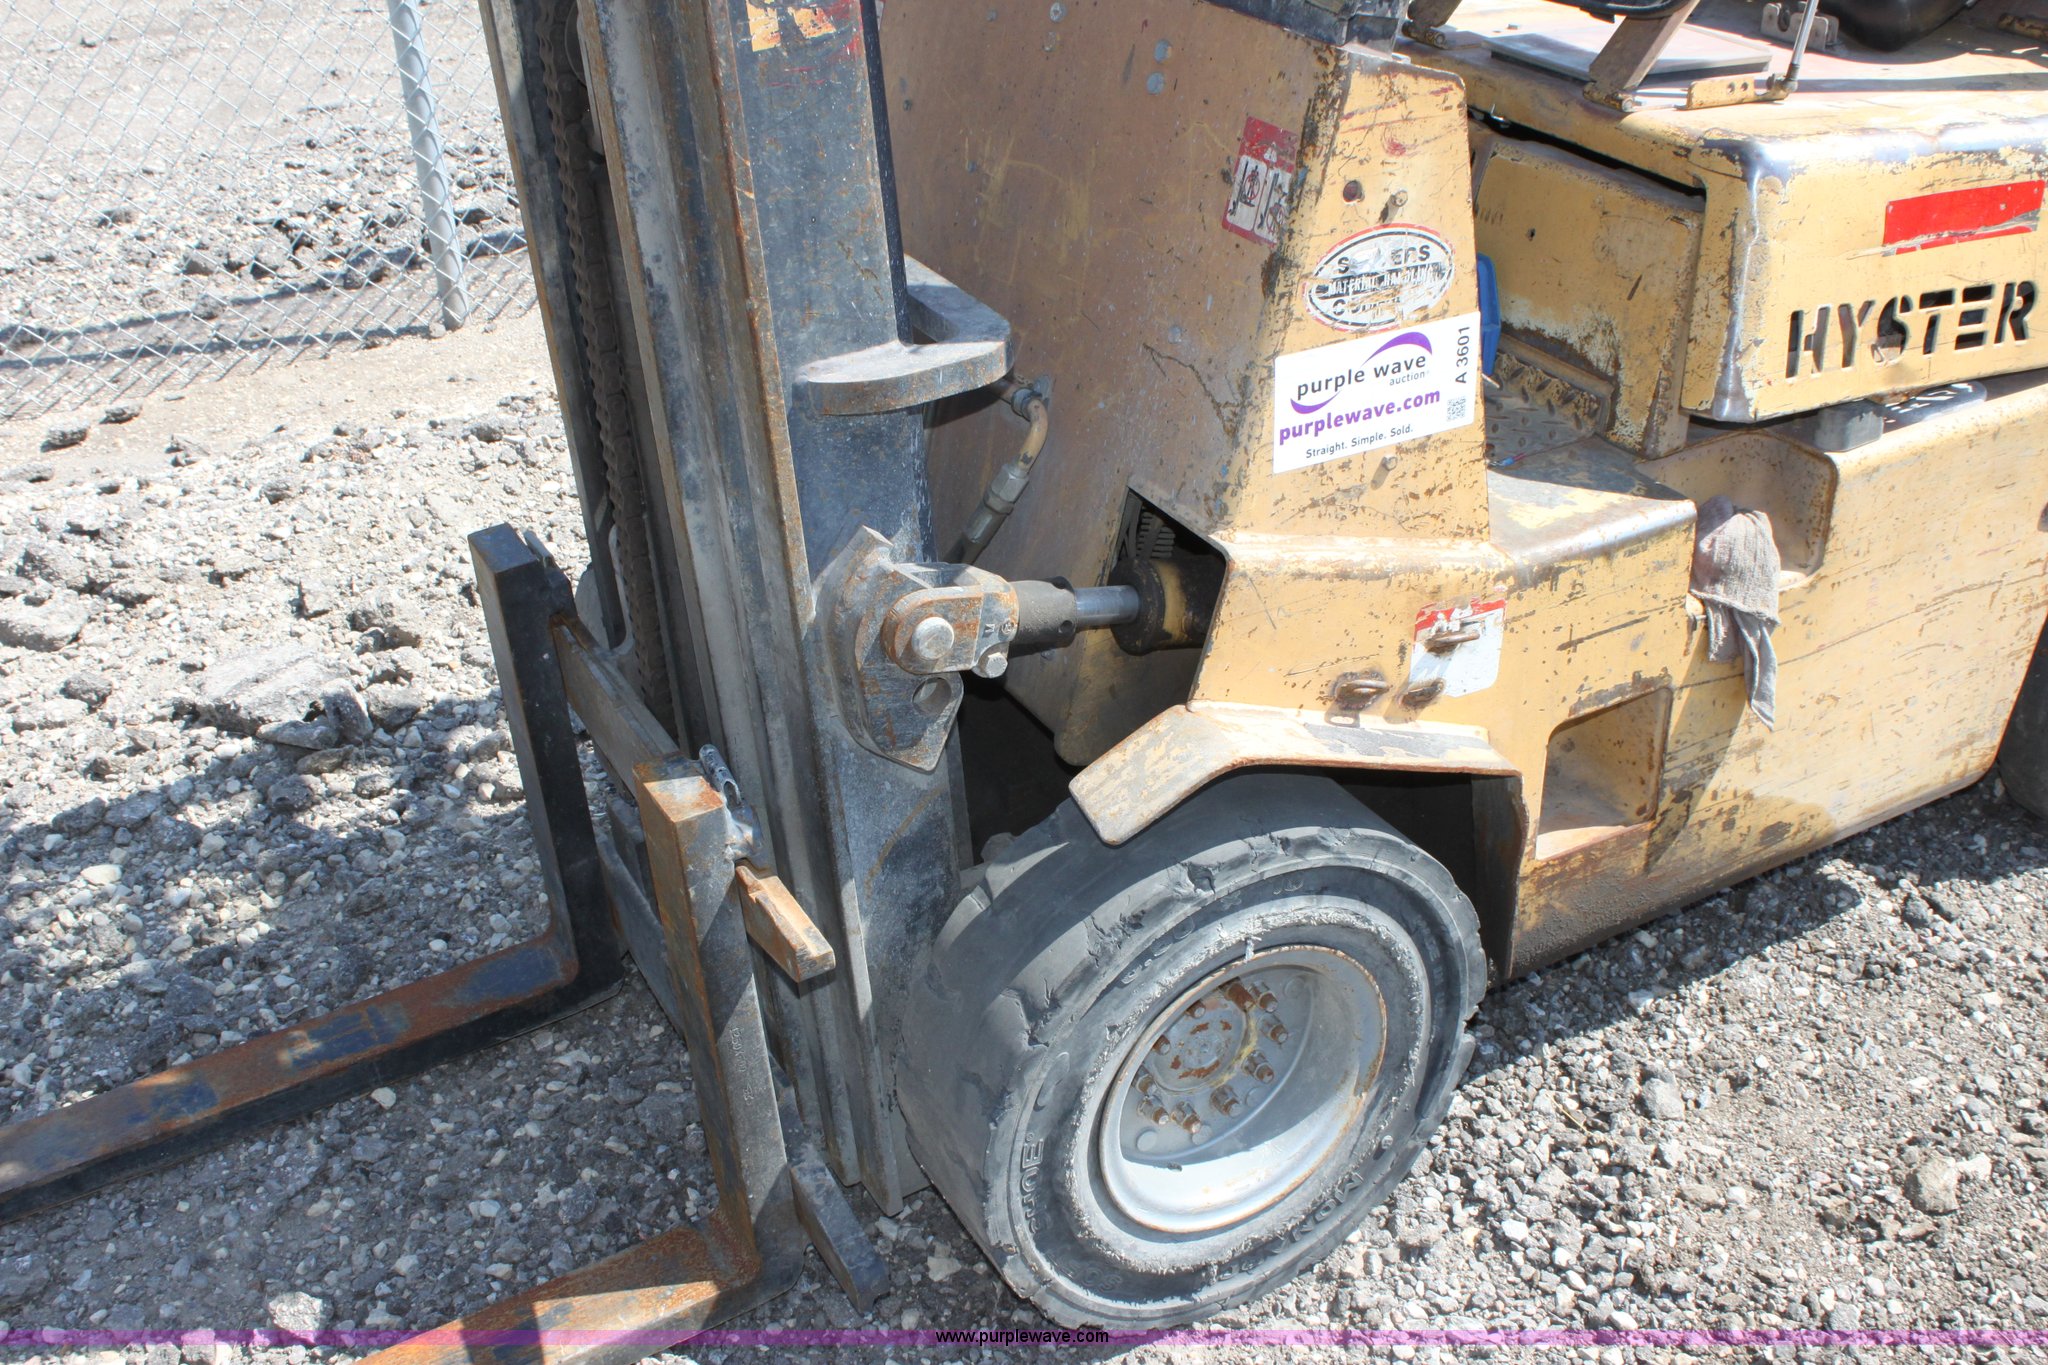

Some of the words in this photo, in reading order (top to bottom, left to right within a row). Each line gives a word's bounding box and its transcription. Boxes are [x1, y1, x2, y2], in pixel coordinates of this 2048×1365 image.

[1456, 326, 1471, 367] 3601
[1785, 280, 2037, 379] HYSTER
[1297, 369, 1366, 400] purple
[1374, 355, 1427, 378] wave
[1389, 371, 1426, 386] auction
[1455, 371, 1467, 384] A
[1279, 390, 1440, 445] purplewave.com
[1306, 441, 1348, 459] Straight.
[1351, 431, 1387, 448] Simple.
[1390, 424, 1413, 437] Sold.
